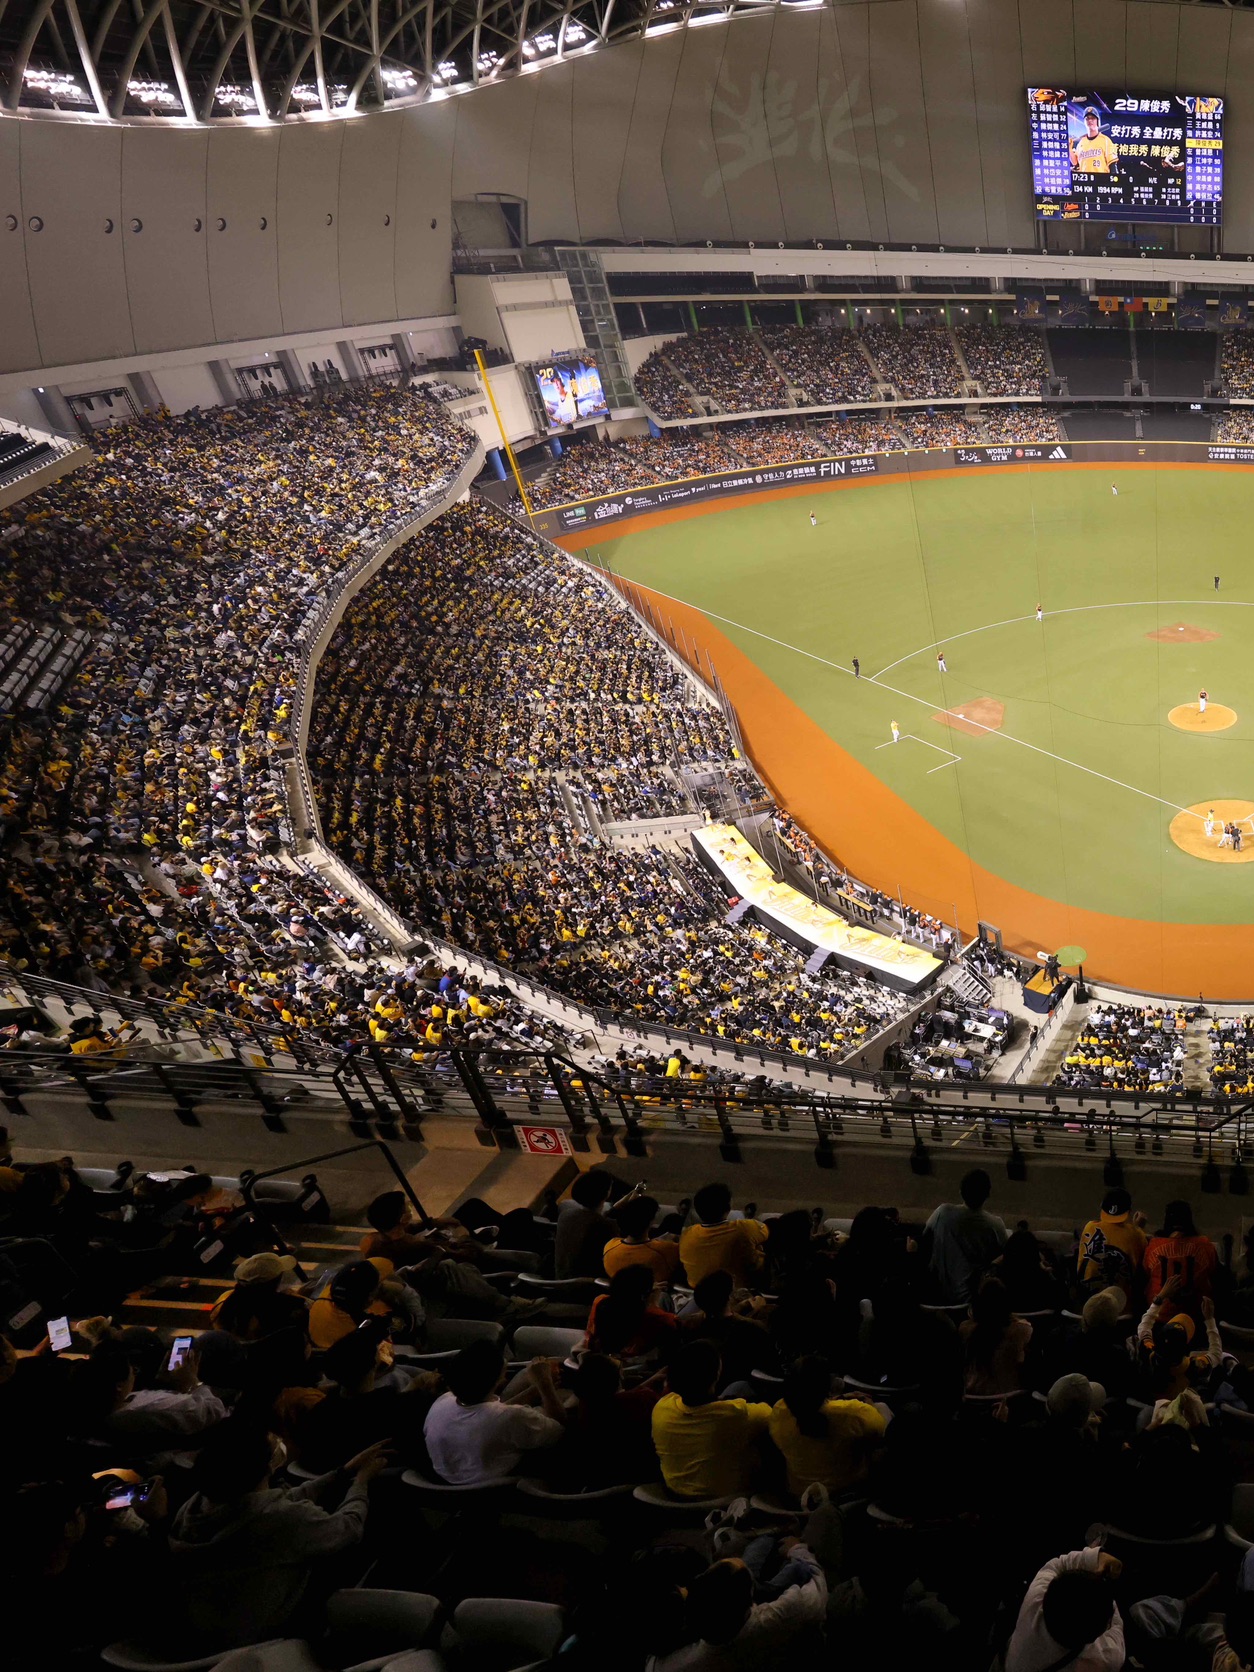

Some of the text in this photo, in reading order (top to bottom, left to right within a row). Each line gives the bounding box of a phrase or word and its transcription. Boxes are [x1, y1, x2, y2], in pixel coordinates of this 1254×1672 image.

[1113, 99, 1171, 113] 29 陳俊秀
[1110, 125, 1183, 140] 安打秀 全壘打秀
[1150, 145, 1180, 158] 陳俊秀
[819, 462, 845, 477] FIN
